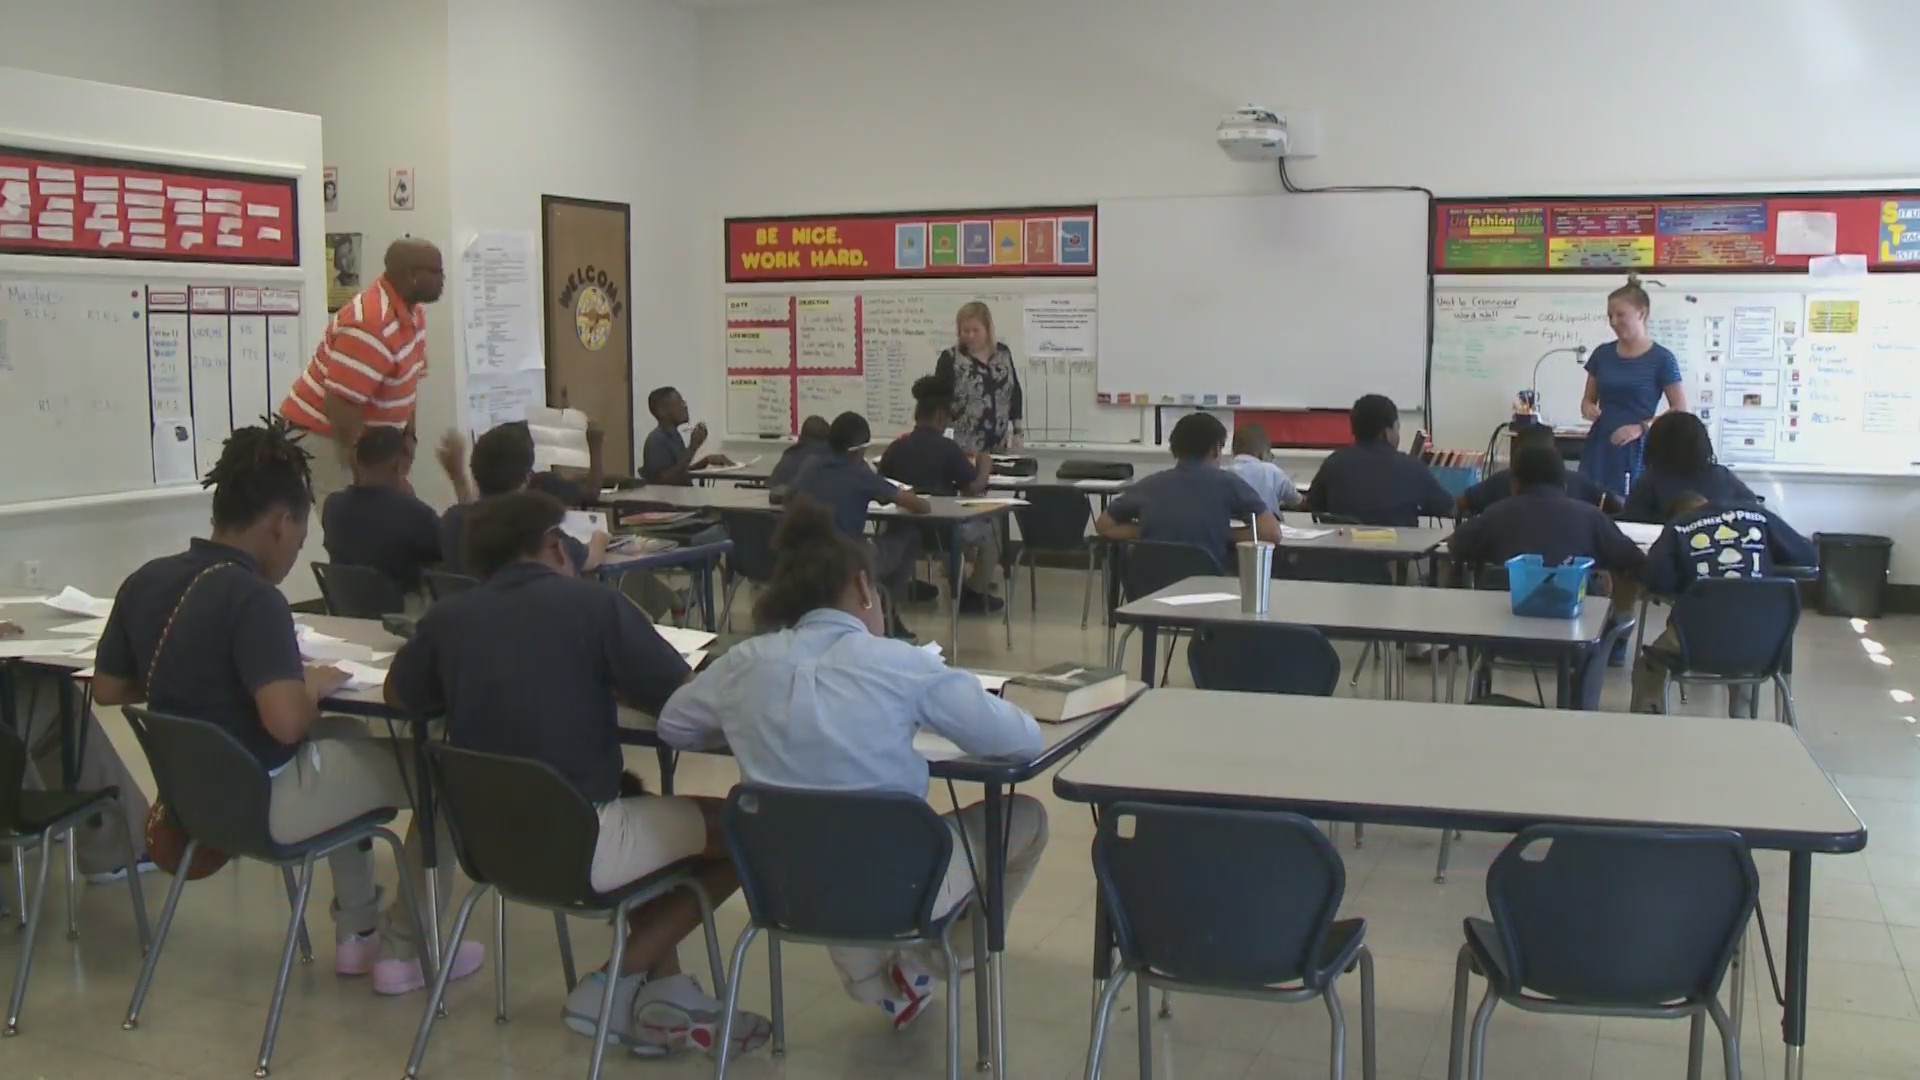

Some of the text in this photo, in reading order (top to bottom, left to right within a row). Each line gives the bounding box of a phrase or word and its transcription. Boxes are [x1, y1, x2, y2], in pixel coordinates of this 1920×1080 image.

[1450, 214, 1543, 227] Unfashionable
[756, 226, 842, 246] BE NICE.
[741, 249, 868, 270] WORK HARD.
[558, 264, 623, 318] WELCOME
[1674, 510, 1767, 534] PHOENIX PRIDE
